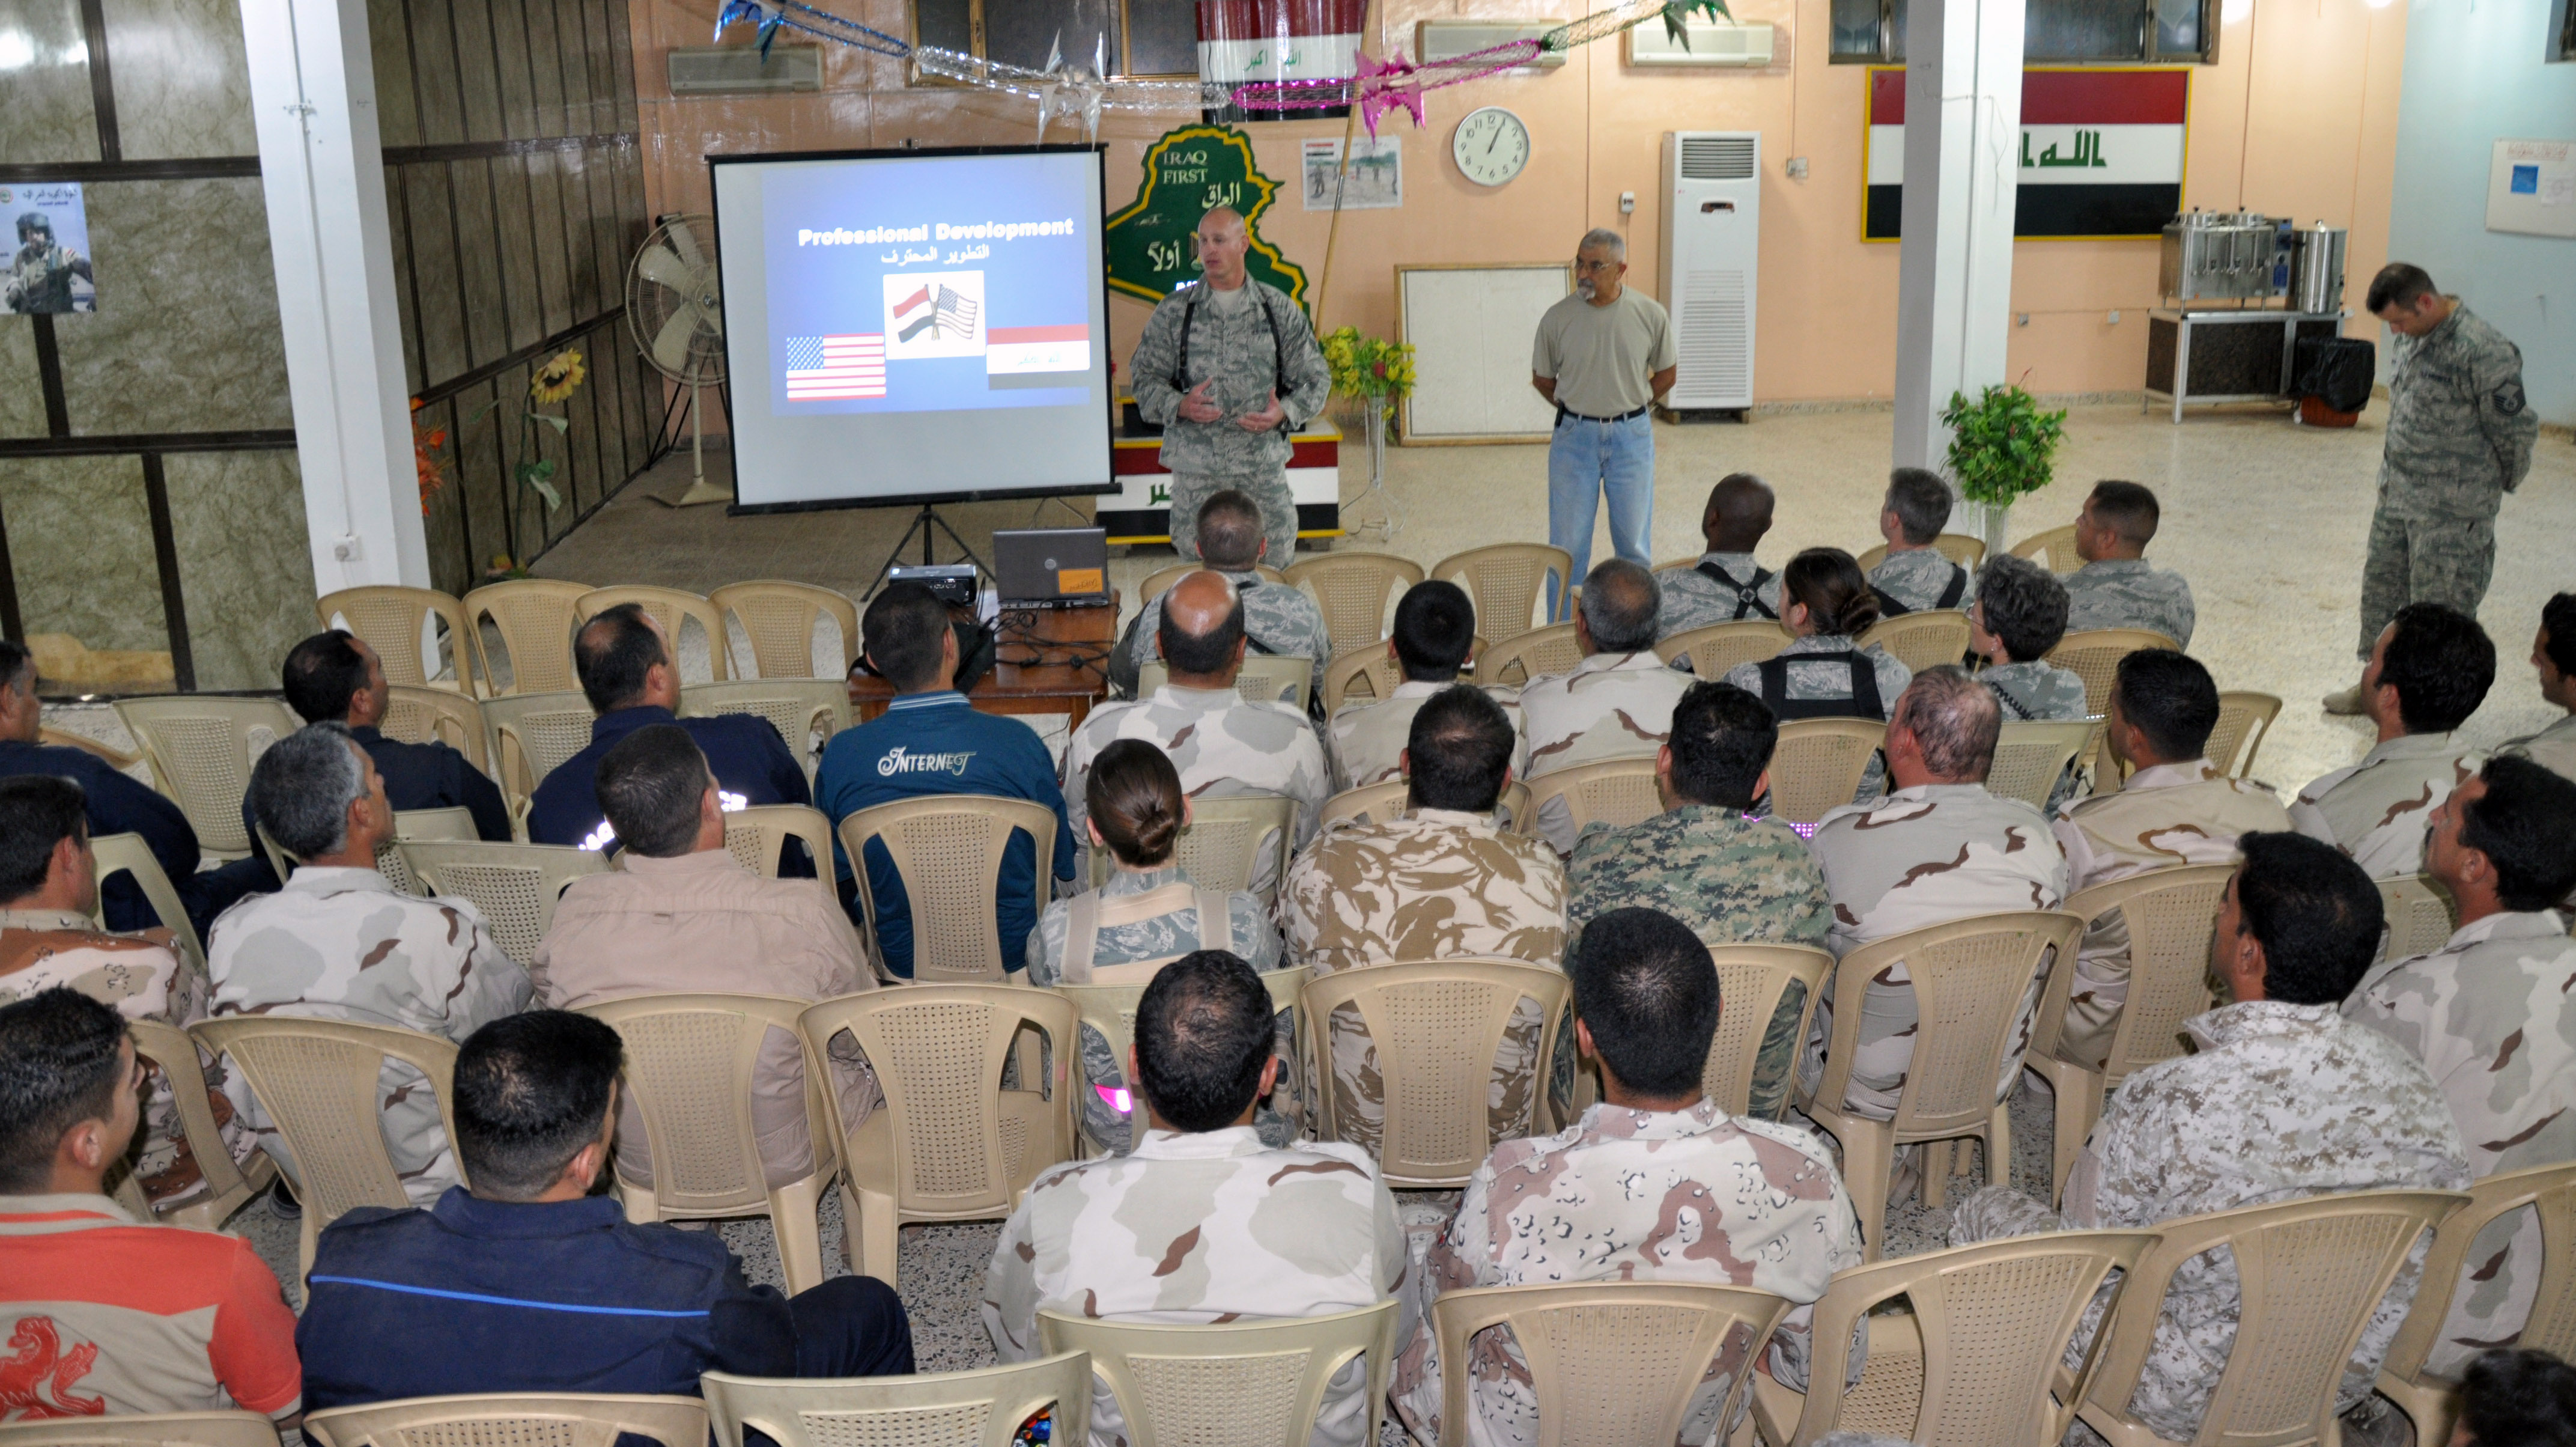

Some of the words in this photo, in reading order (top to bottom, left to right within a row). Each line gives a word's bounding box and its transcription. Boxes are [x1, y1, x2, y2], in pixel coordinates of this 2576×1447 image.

[1475, 119, 1482, 129] 11
[1488, 114, 1496, 125] 12
[1466, 128, 1475, 138] 10
[1511, 127, 1518, 138] 2
[1461, 142, 1466, 151] 9
[1516, 141, 1522, 151] 3
[2038, 128, 2107, 167] الله
[1164, 150, 1208, 165] IRAQ
[1465, 156, 1471, 166] 8
[1512, 155, 1518, 163] 4
[1477, 165, 1483, 175] 7
[1489, 169, 1495, 178] 6
[1502, 164, 1508, 175] 5
[1163, 168, 1208, 184] FIRST
[1201, 181, 1241, 209] العراق
[798, 224, 928, 246] Professional
[935, 218, 1074, 241] Development
[943, 243, 990, 264] التطوير
